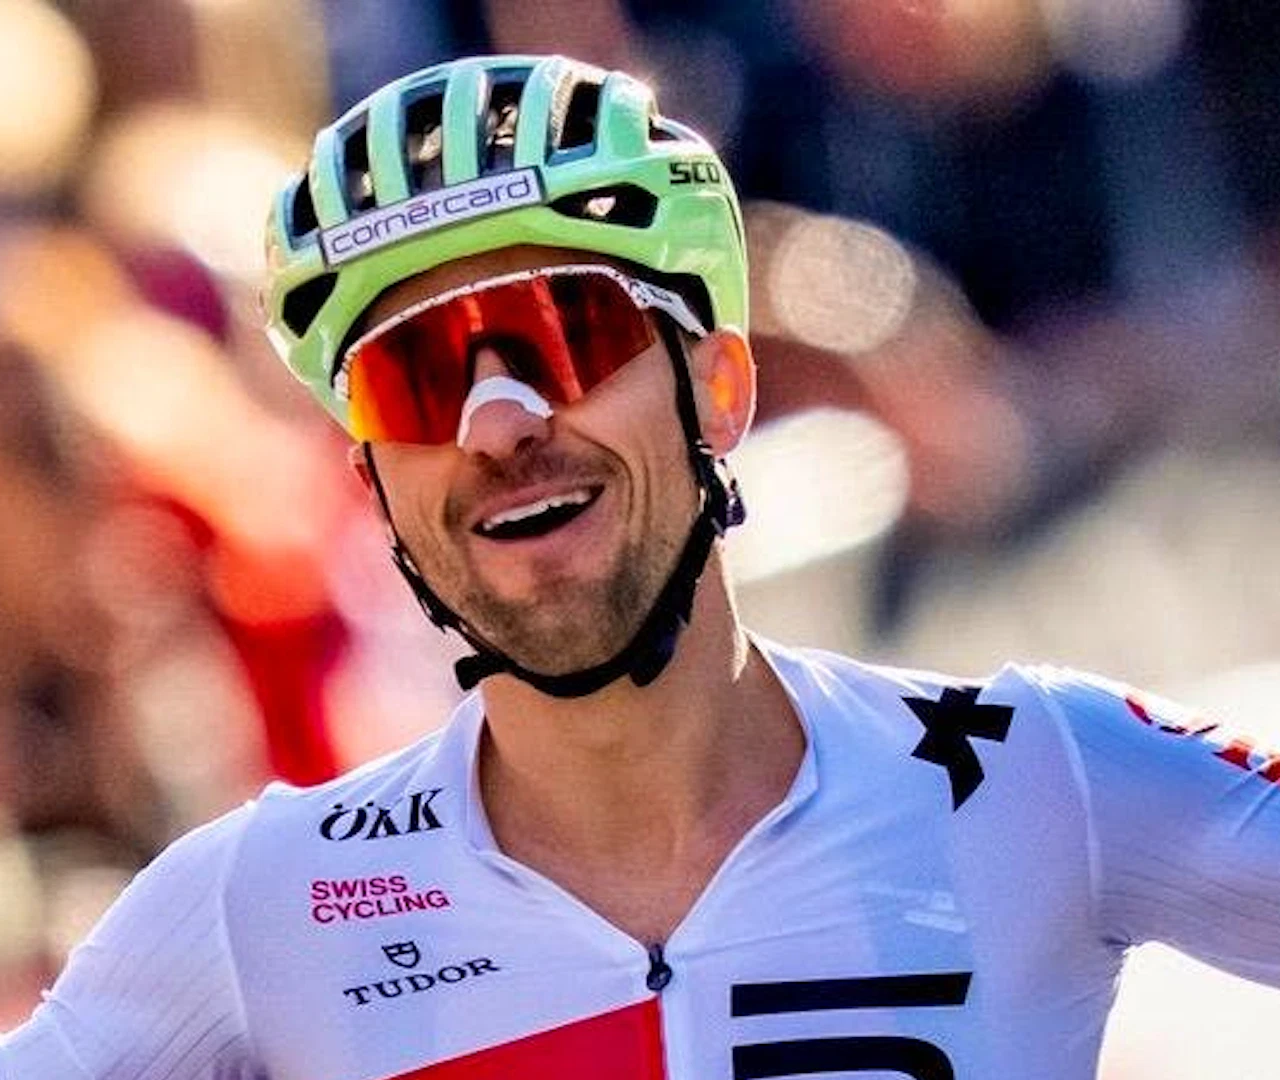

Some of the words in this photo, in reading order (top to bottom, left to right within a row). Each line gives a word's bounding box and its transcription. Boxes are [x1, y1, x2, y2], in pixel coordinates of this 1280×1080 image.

[669, 162, 721, 185] SCO
[311, 875, 408, 900] SWISS
[312, 889, 450, 924] CYCLING
[343, 957, 501, 1006] TUDOR
